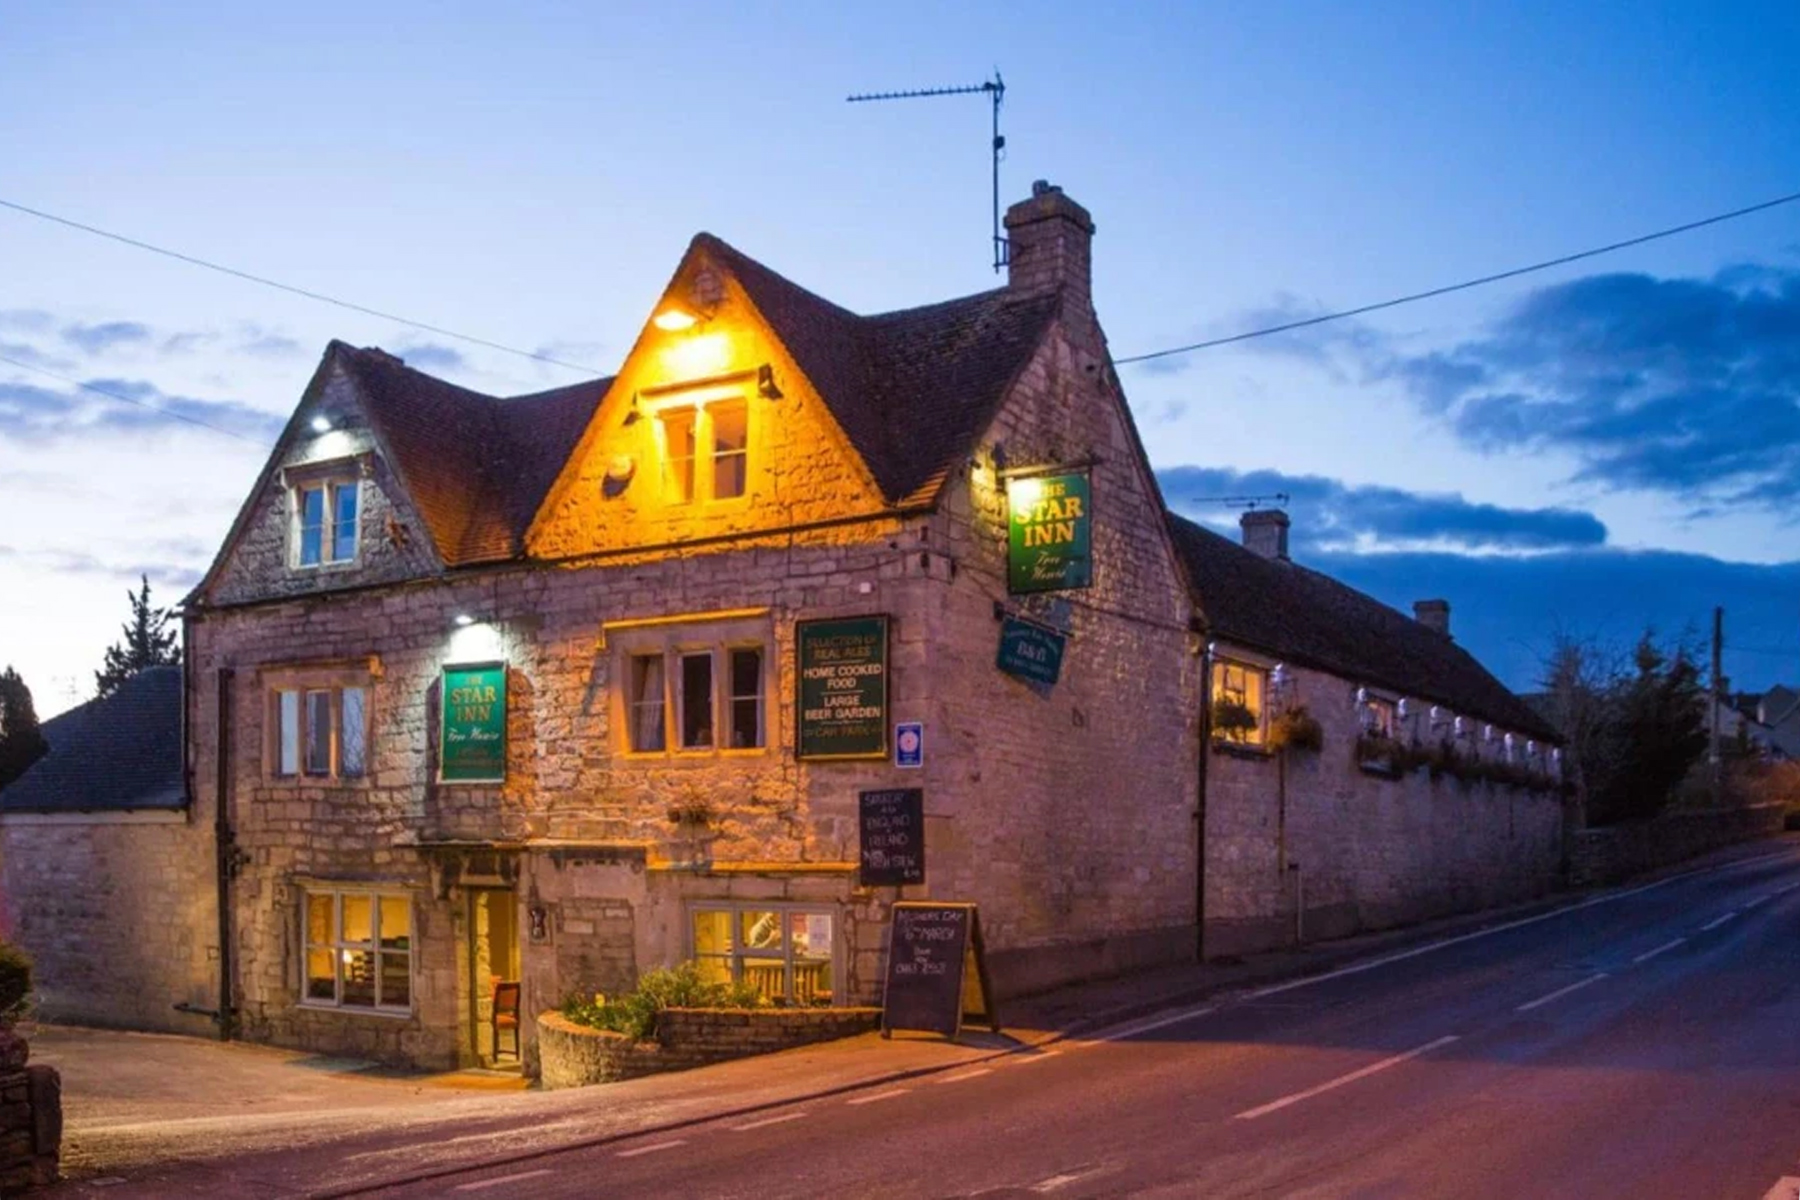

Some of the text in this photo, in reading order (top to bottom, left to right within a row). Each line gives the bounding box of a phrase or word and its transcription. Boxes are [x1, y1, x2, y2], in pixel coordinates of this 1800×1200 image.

[1015, 497, 1084, 525] STAR
[1024, 521, 1075, 547] INN
[814, 648, 841, 660] REAL
[803, 663, 882, 679] HOME COOKED
[827, 678, 857, 690] FOOD
[451, 686, 497, 704] STAR
[824, 695, 860, 707] LARGE
[456, 704, 491, 723] INN
[804, 706, 881, 721] BEER GARDEN
